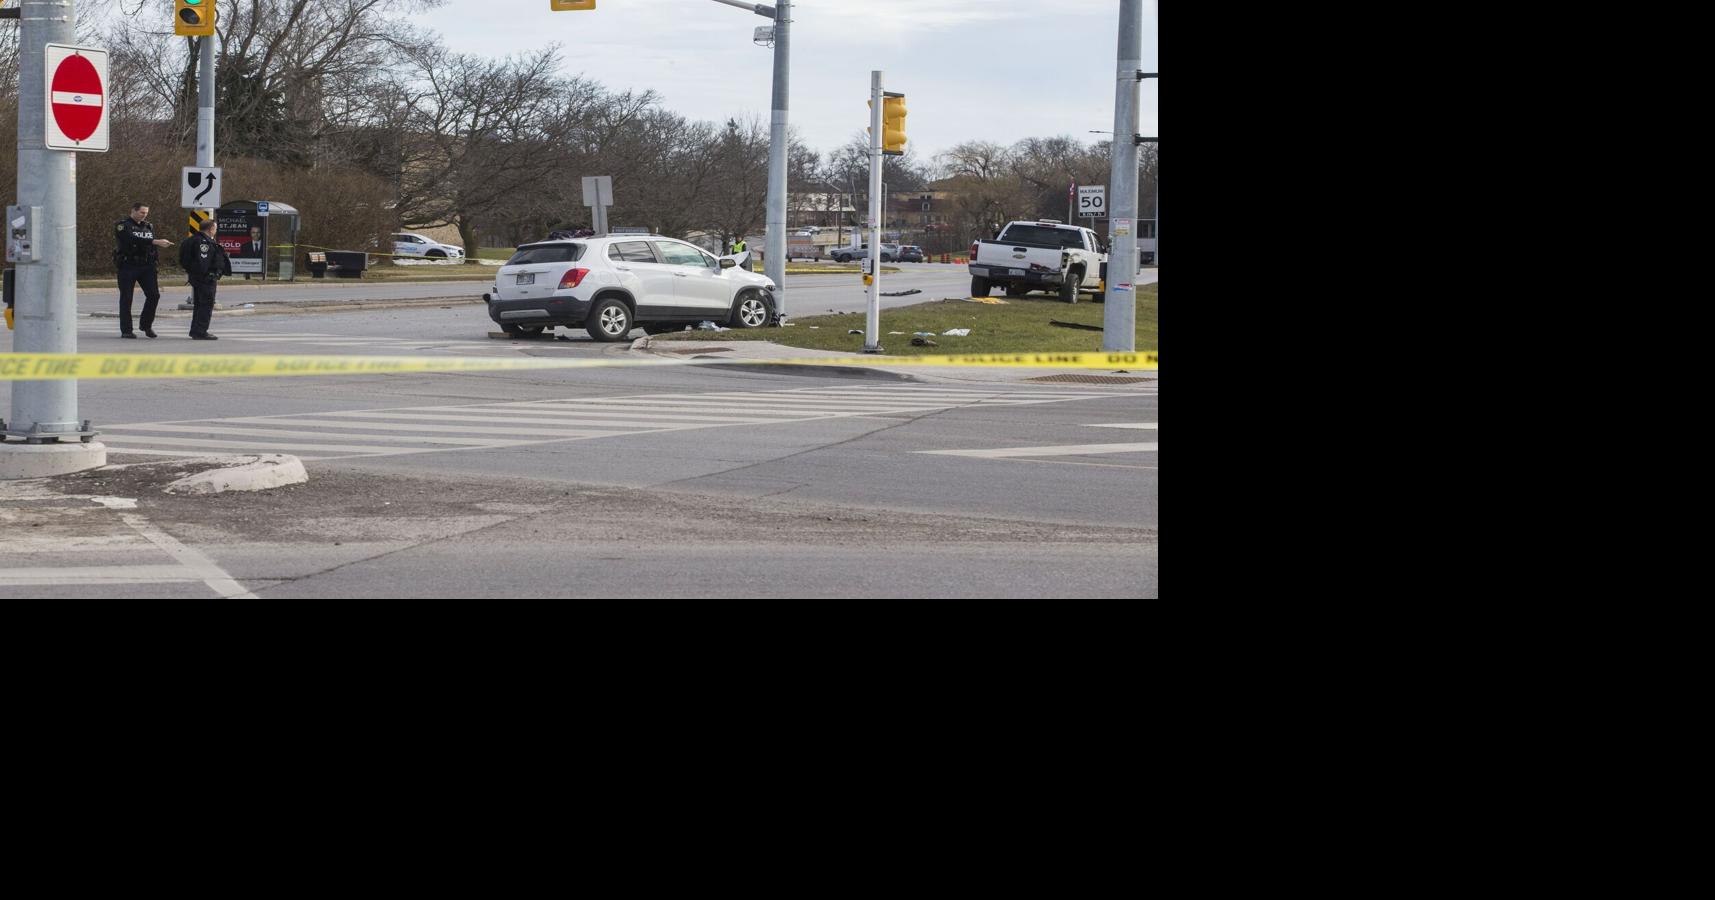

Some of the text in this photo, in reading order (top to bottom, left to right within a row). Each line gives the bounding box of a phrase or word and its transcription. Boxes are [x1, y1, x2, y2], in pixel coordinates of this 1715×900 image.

[1081, 196, 1103, 208] 50
[133, 231, 154, 239] POLICE
[947, 355, 1024, 364] POLICE
[1035, 354, 1082, 364] LINE
[1107, 354, 1137, 364] DO
